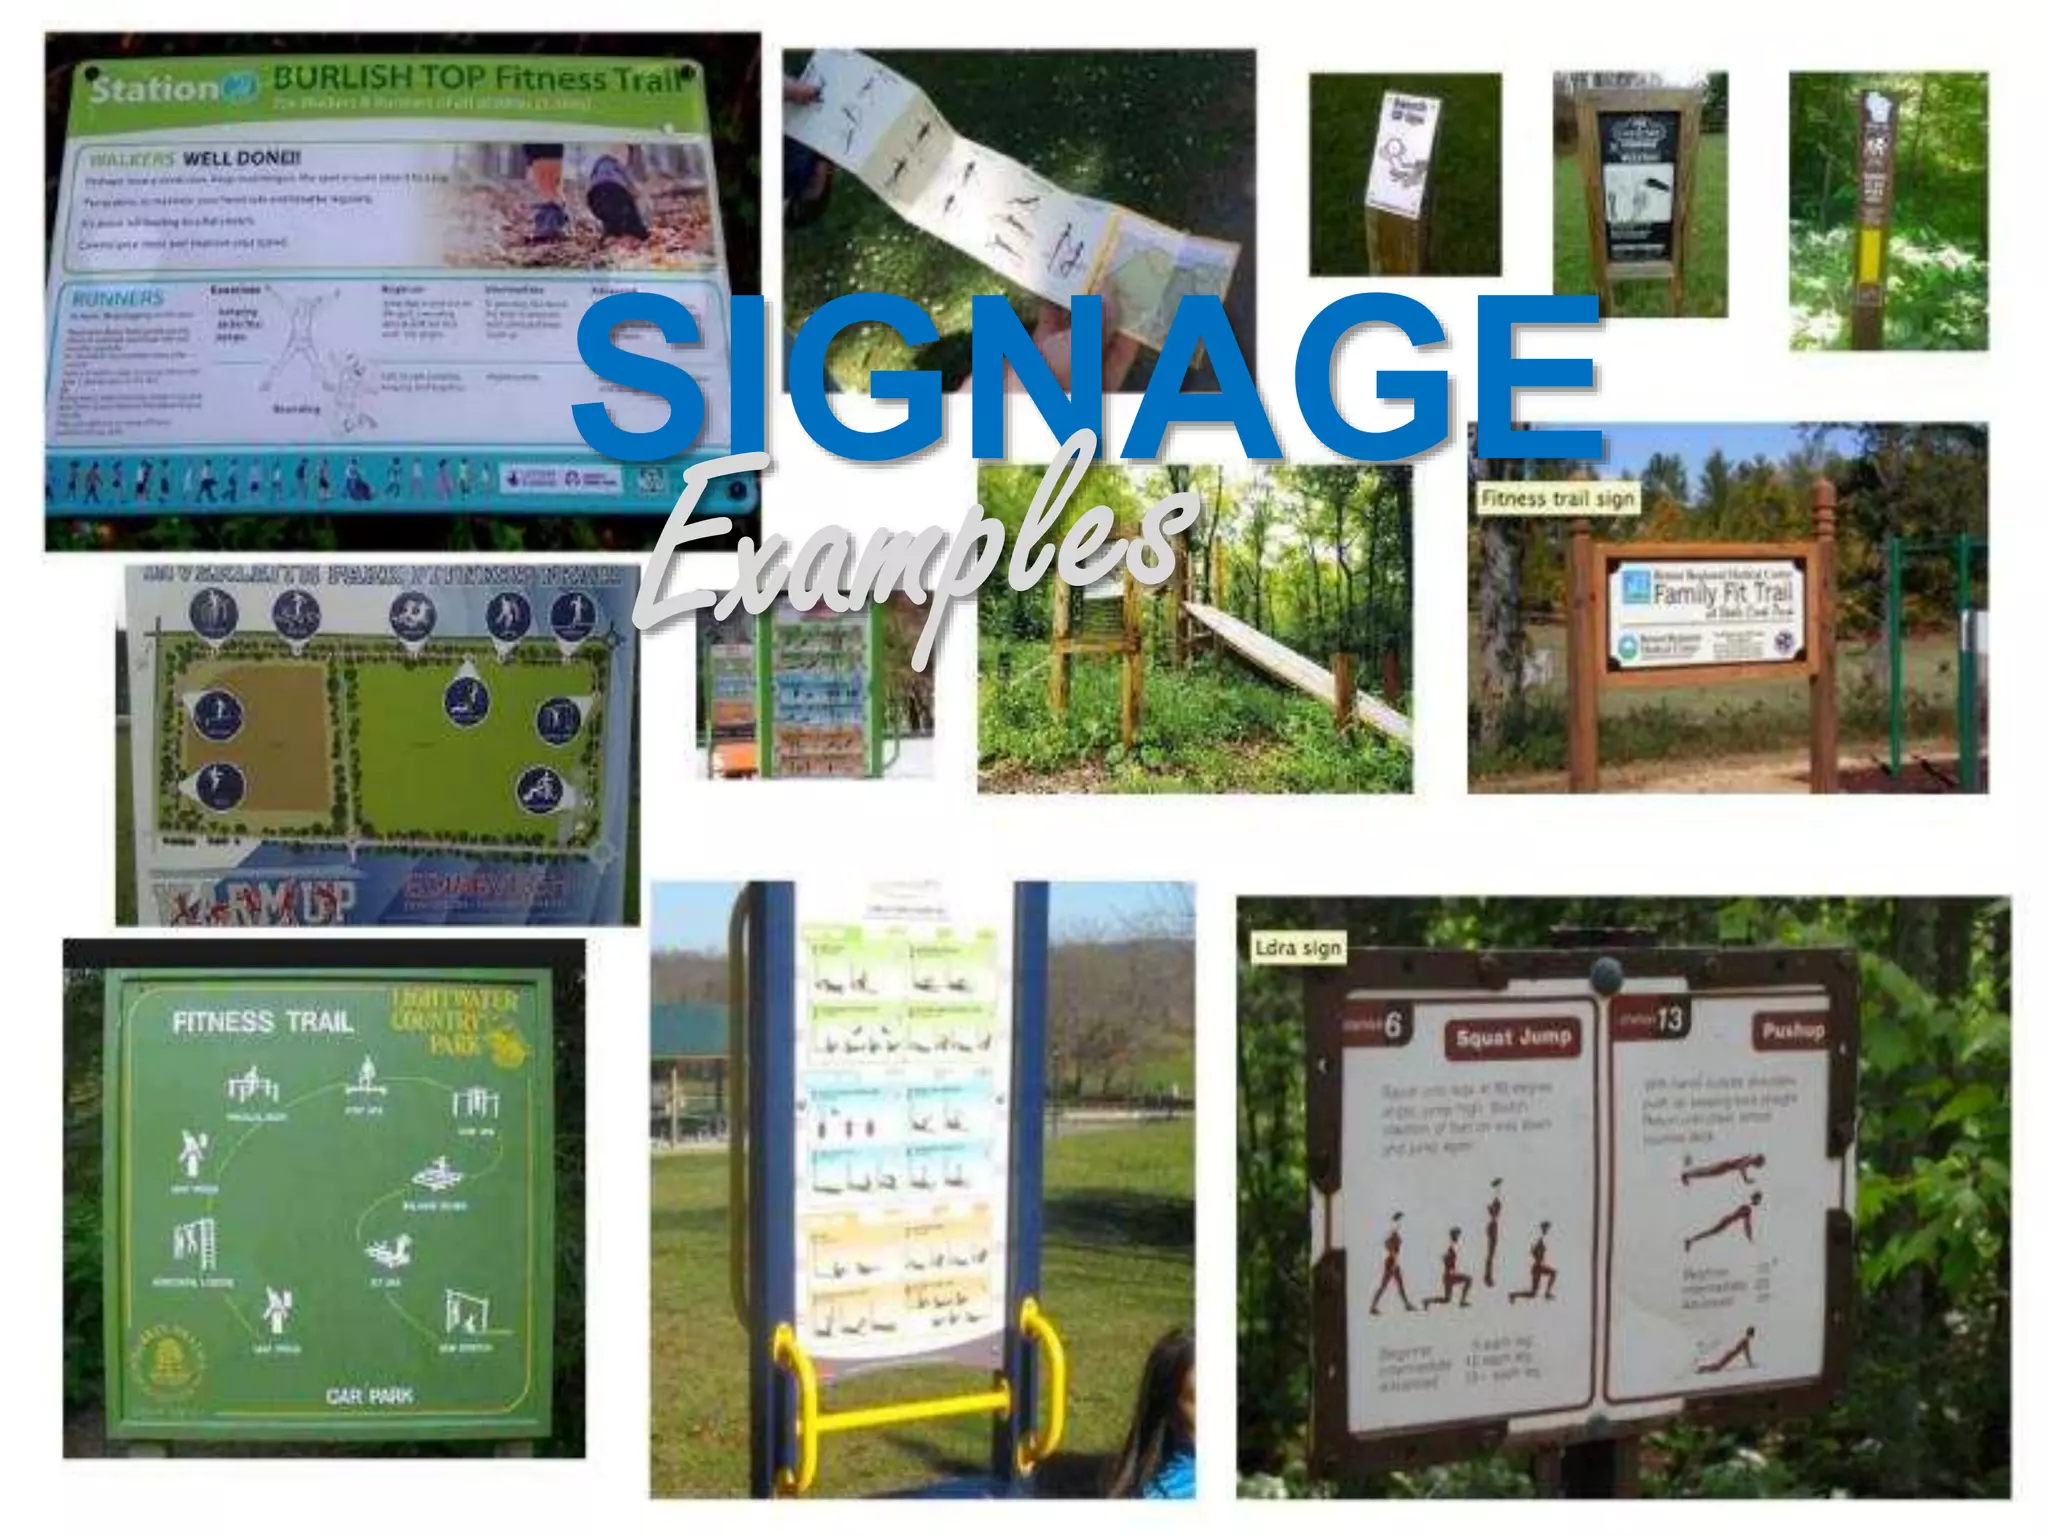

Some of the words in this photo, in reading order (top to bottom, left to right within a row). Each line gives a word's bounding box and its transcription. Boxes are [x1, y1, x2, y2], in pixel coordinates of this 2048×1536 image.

[90, 75, 220, 104] Station
[273, 63, 414, 91] BURLISH
[420, 64, 487, 91] TOP
[496, 64, 607, 93] Fitness
[613, 66, 682, 94] Trail
[183, 151, 233, 167] WELL
[71, 288, 165, 307] RUNNERS
[1654, 580, 1718, 608] Family
[1723, 582, 1747, 602] Fit
[1754, 580, 1793, 601] Trail
[172, 1009, 276, 1034] FITNESS
[285, 1009, 355, 1033] TRAIL
[1384, 1010, 1402, 1039] 6
[1657, 1005, 1684, 1032] 13
[1456, 1029, 1514, 1049] Squat
[1519, 1027, 1574, 1048] Jump
[1762, 1021, 1827, 1043] Pushup
[326, 1386, 363, 1405] CAR
[368, 1386, 416, 1405] PARK
